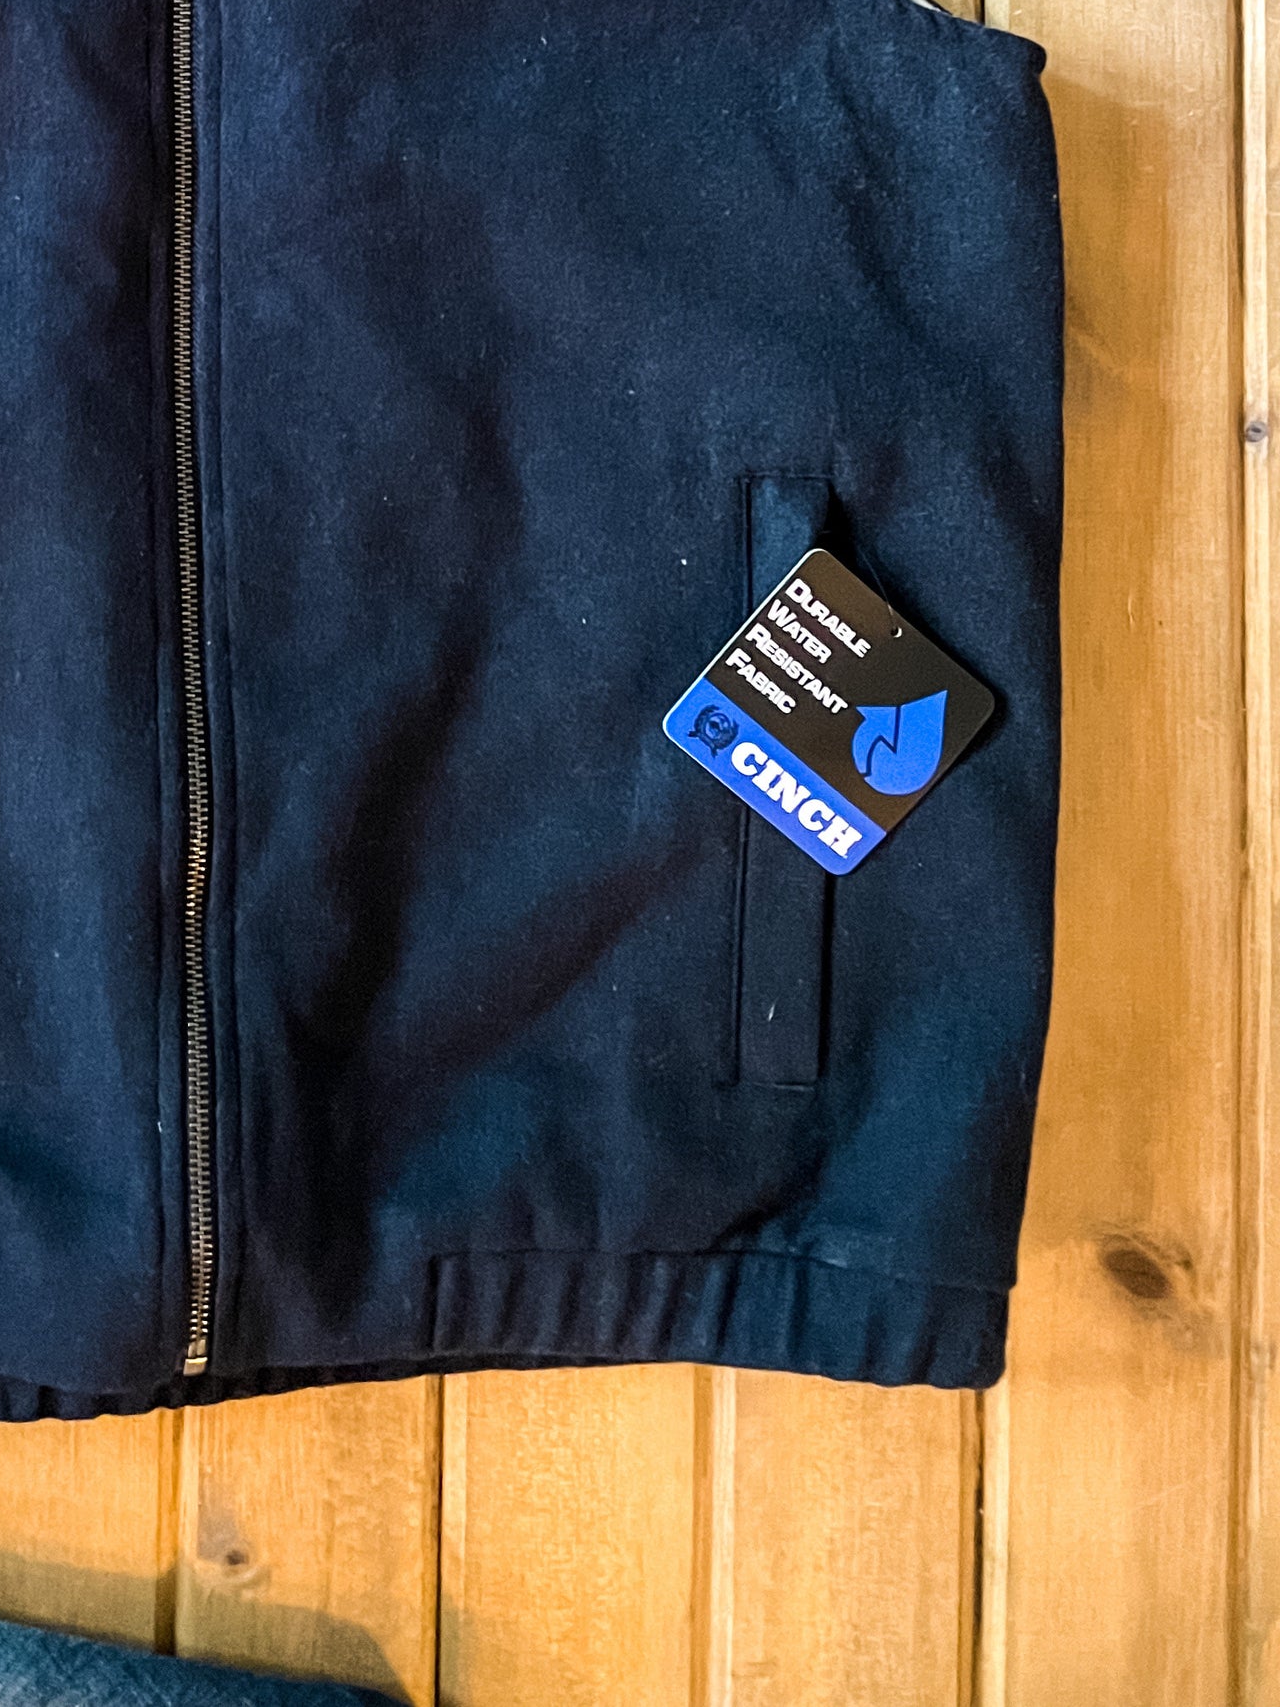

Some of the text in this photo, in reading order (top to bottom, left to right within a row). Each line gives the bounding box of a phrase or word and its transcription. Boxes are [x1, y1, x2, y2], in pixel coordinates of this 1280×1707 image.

[767, 599, 831, 663] WATER
[785, 578, 871, 658] DURABLE
[725, 648, 796, 714] FABRIC
[745, 623, 848, 714] RESISTANT
[731, 741, 862, 858] CINCH
